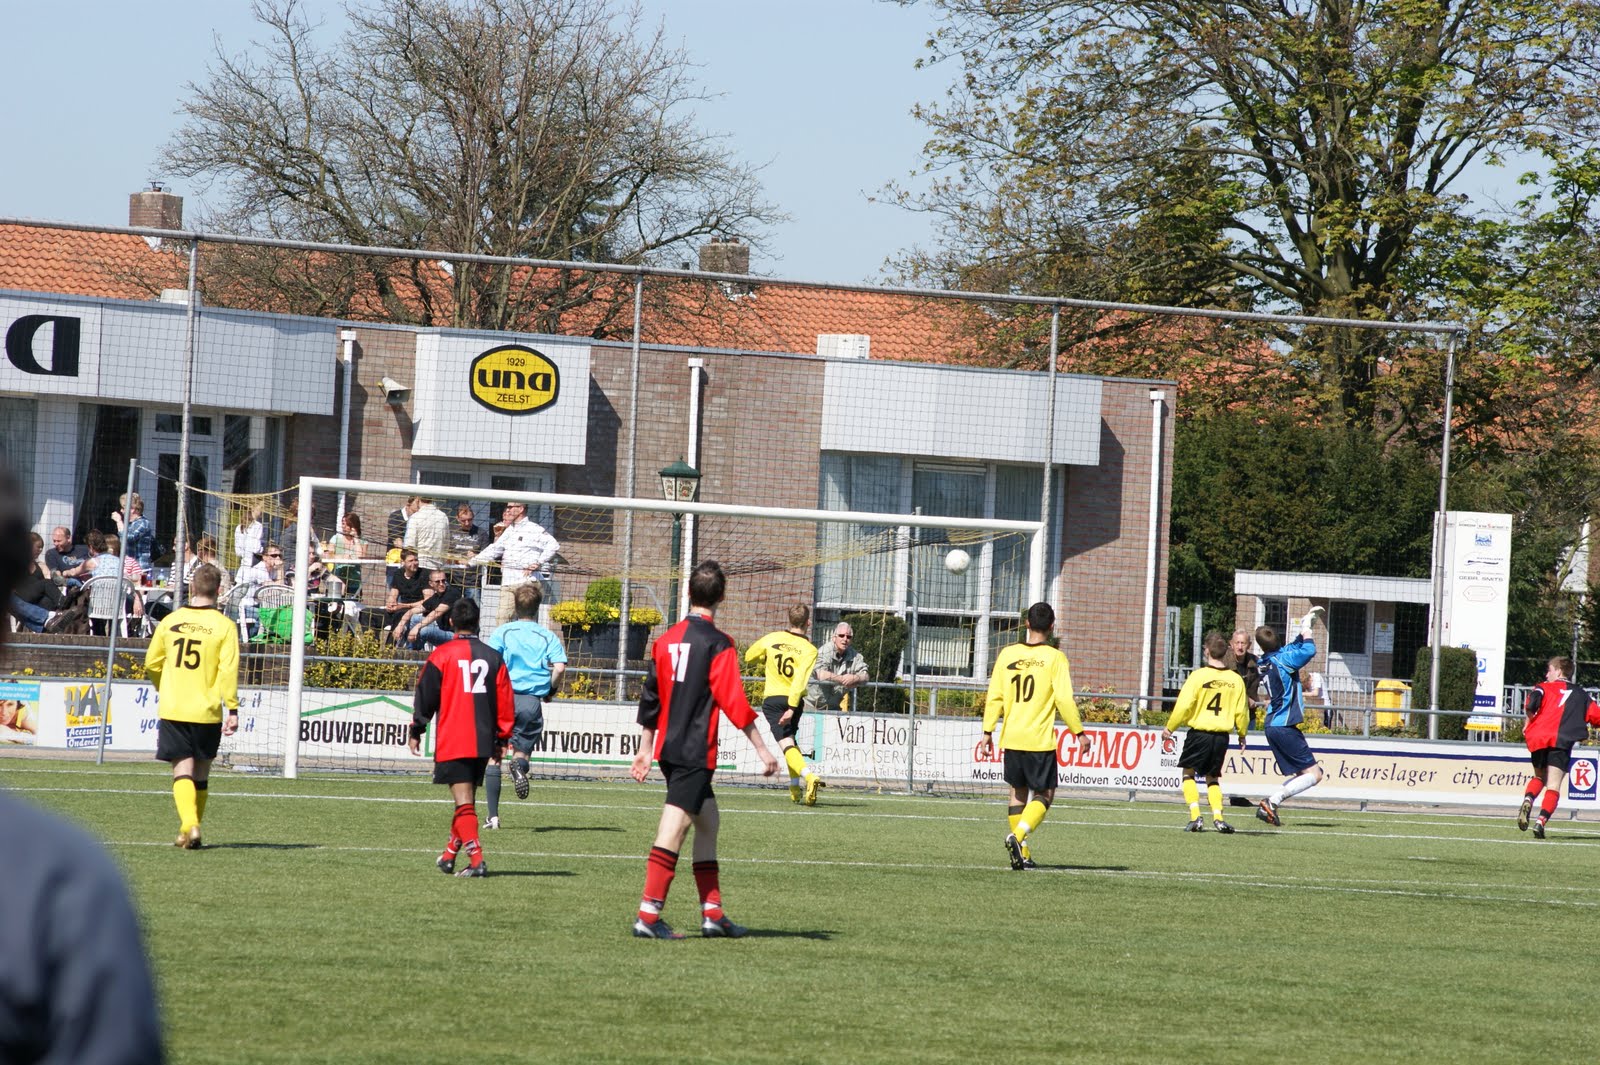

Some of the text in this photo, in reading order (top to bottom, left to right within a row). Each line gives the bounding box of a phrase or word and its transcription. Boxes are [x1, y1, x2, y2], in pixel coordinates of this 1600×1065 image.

[506, 357, 526, 367] 1929
[478, 368, 551, 391] una
[496, 393, 530, 404] ZEELST
[173, 637, 202, 670] 15
[667, 642, 691, 682] 11
[774, 653, 795, 678] 16
[457, 658, 489, 693] 12
[1011, 673, 1035, 703] 10
[1558, 689, 1573, 707] 7
[1206, 692, 1222, 716] 4
[299, 720, 408, 747] BOUWBEDRIJ
[836, 717, 865, 744] Van
[533, 730, 641, 756] NTVOORT BV
[825, 747, 933, 767] PARTY SERVCE
[1160, 758, 1177, 768] BOVAG
[1058, 772, 1109, 785] Veldhoven
[1121, 775, 1180, 788] 040-2530000
[1338, 760, 1437, 787] keurslager
[1453, 767, 1484, 789] city
[1488, 771, 1534, 786] centr
[1574, 768, 1591, 787] K
